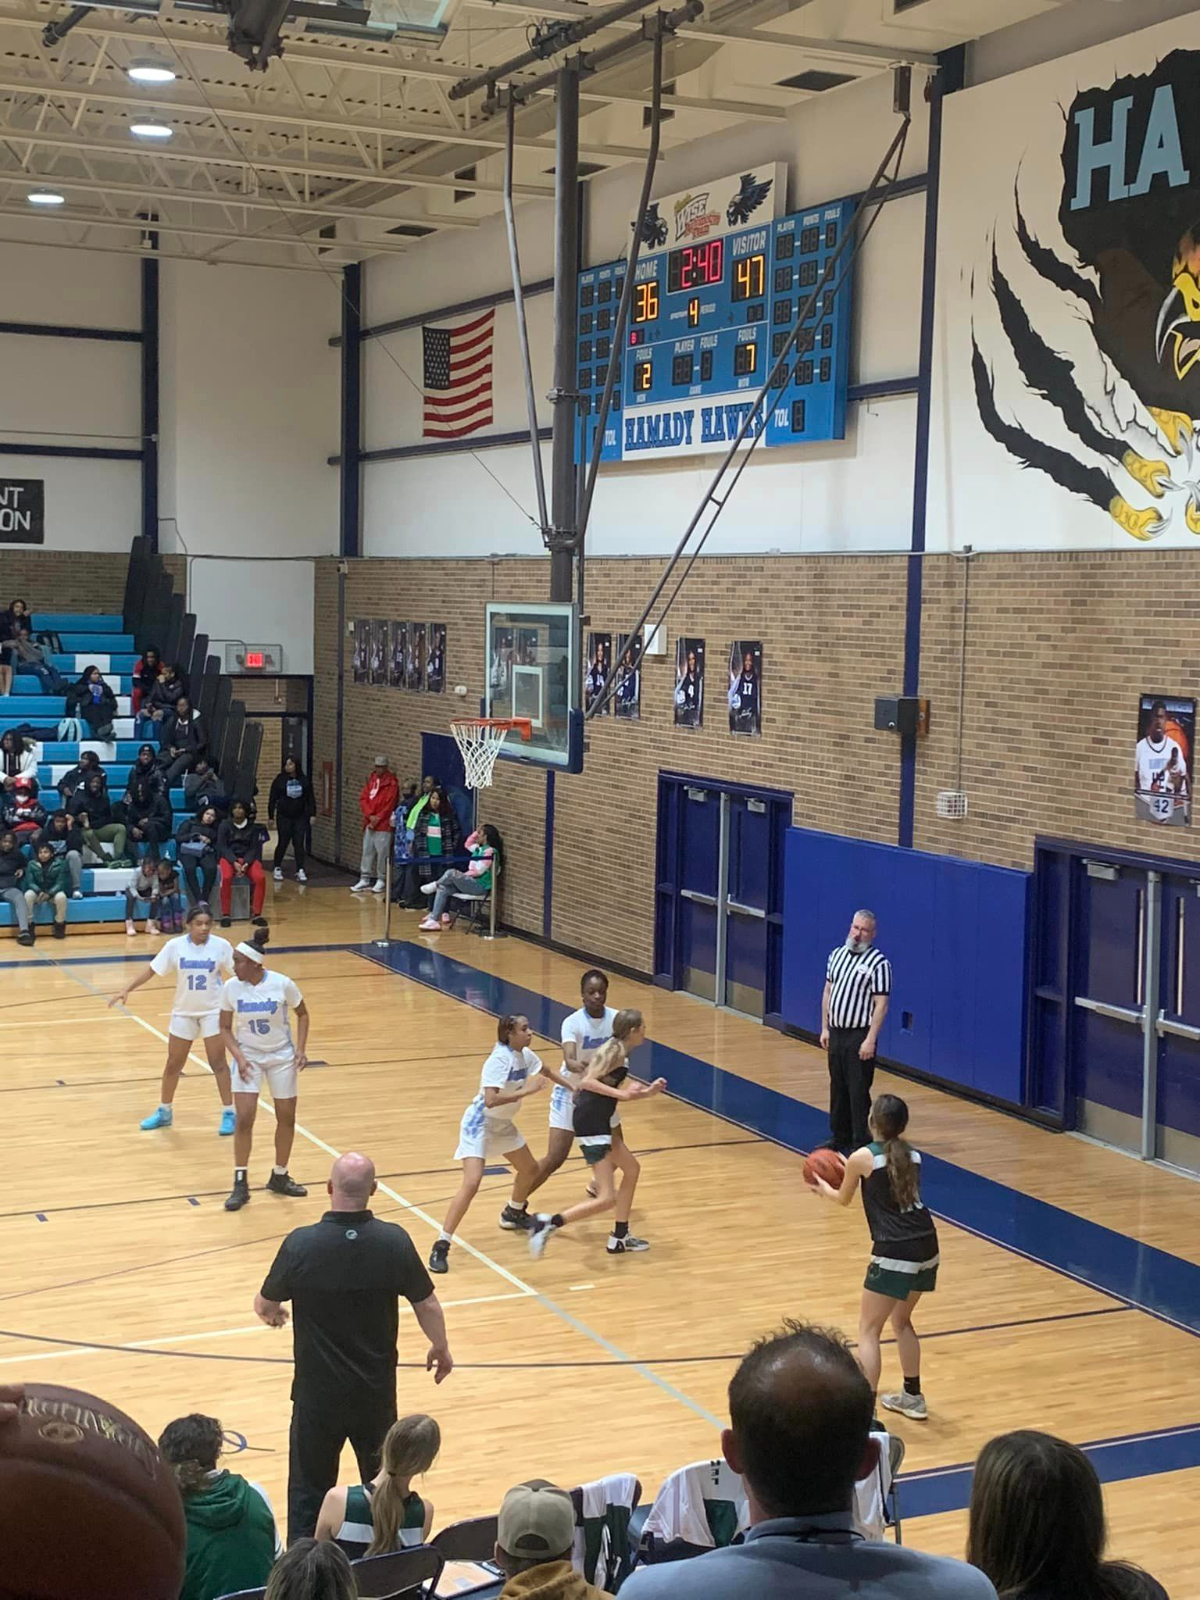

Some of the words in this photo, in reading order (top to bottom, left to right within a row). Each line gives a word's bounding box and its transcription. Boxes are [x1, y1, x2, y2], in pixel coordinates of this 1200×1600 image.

[732, 231, 767, 256] VISITOR
[634, 259, 658, 281] HOME
[681, 241, 722, 288] 2:40
[737, 255, 764, 298] 47
[636, 281, 658, 322] 36
[689, 299, 698, 325] 4
[674, 339, 695, 354] PLAYER
[746, 344, 756, 371] 7
[642, 363, 651, 389] 2
[625, 410, 695, 451] HAMADY
[774, 408, 789, 428] TOL
[1153, 799, 1170, 813] 42
[187, 974, 207, 991] 12
[248, 1018, 270, 1035] 15
